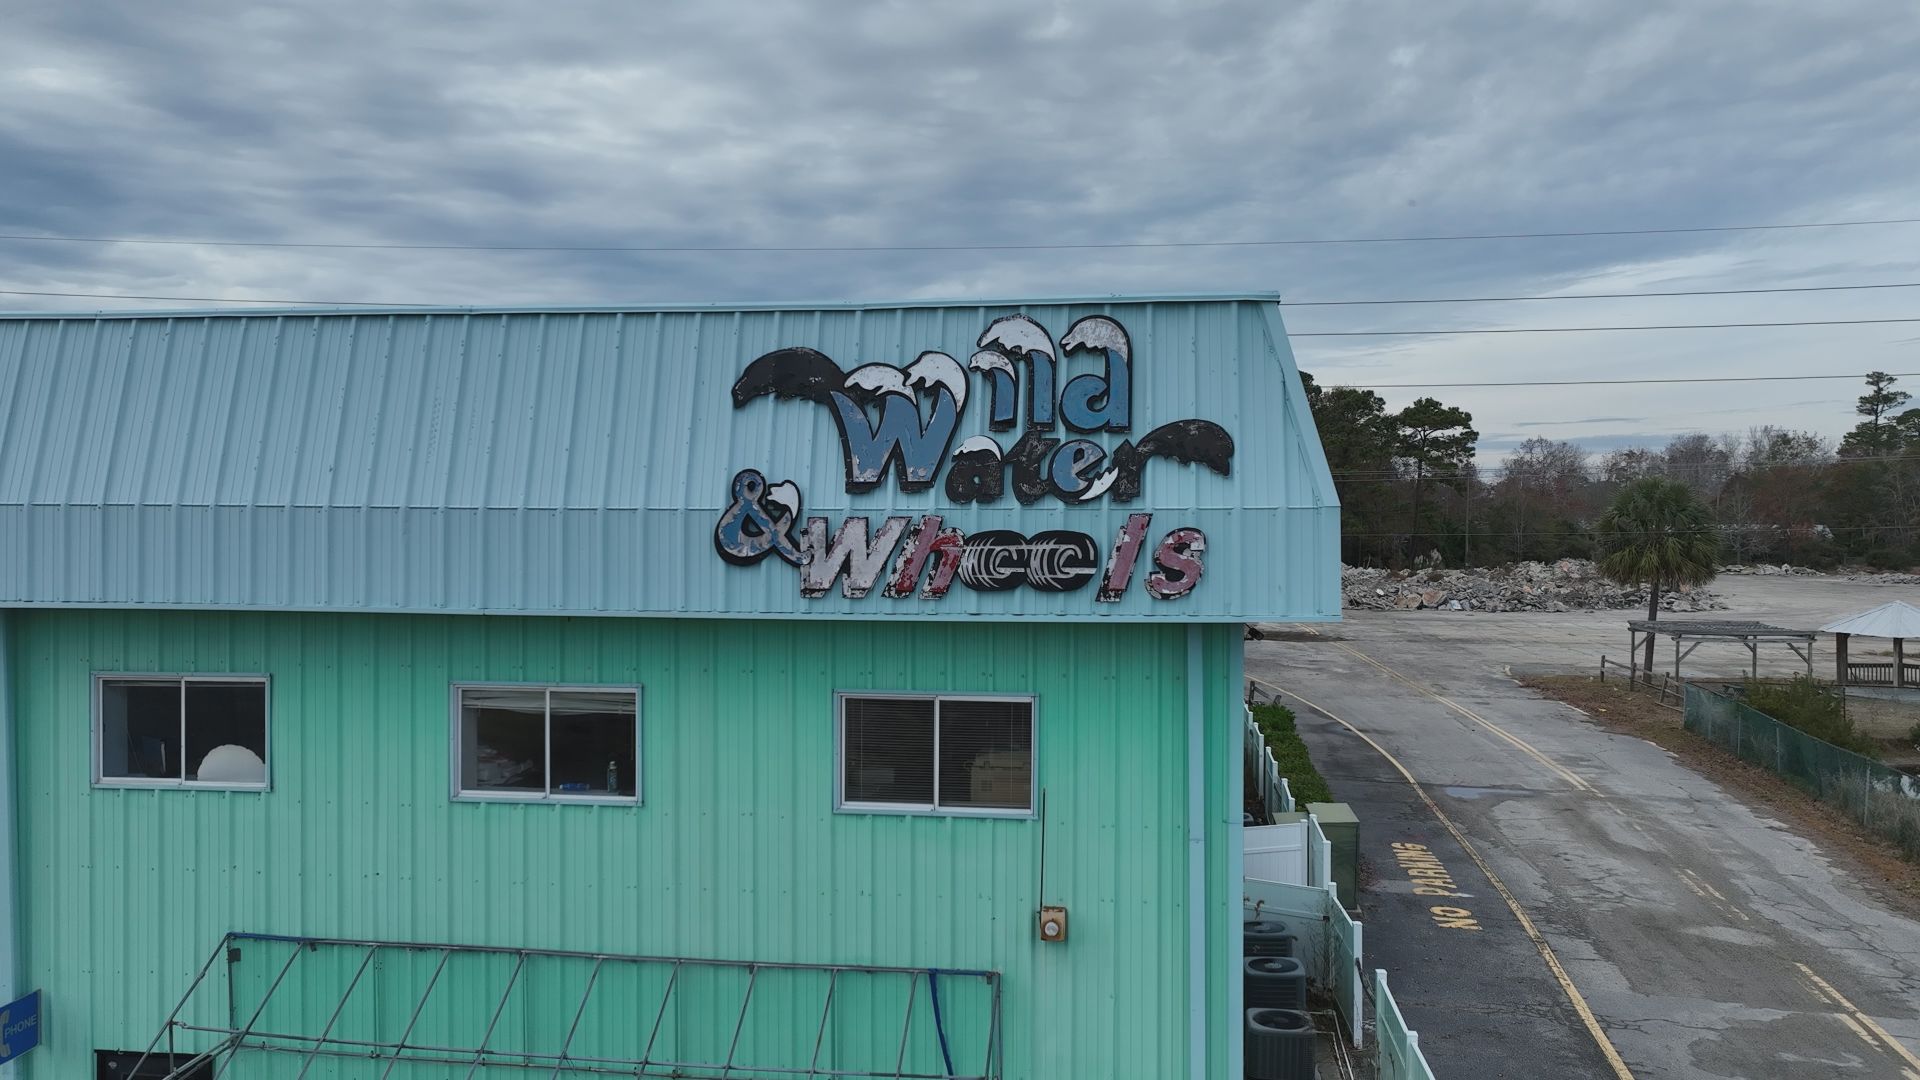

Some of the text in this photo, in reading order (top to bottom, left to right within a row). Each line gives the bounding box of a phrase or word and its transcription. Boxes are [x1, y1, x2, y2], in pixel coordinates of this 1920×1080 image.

[732, 314, 1133, 494] Wild
[714, 469, 811, 567] &
[1391, 842, 1483, 930] NO PARKING
[4, 1013, 38, 1039] PHONE
